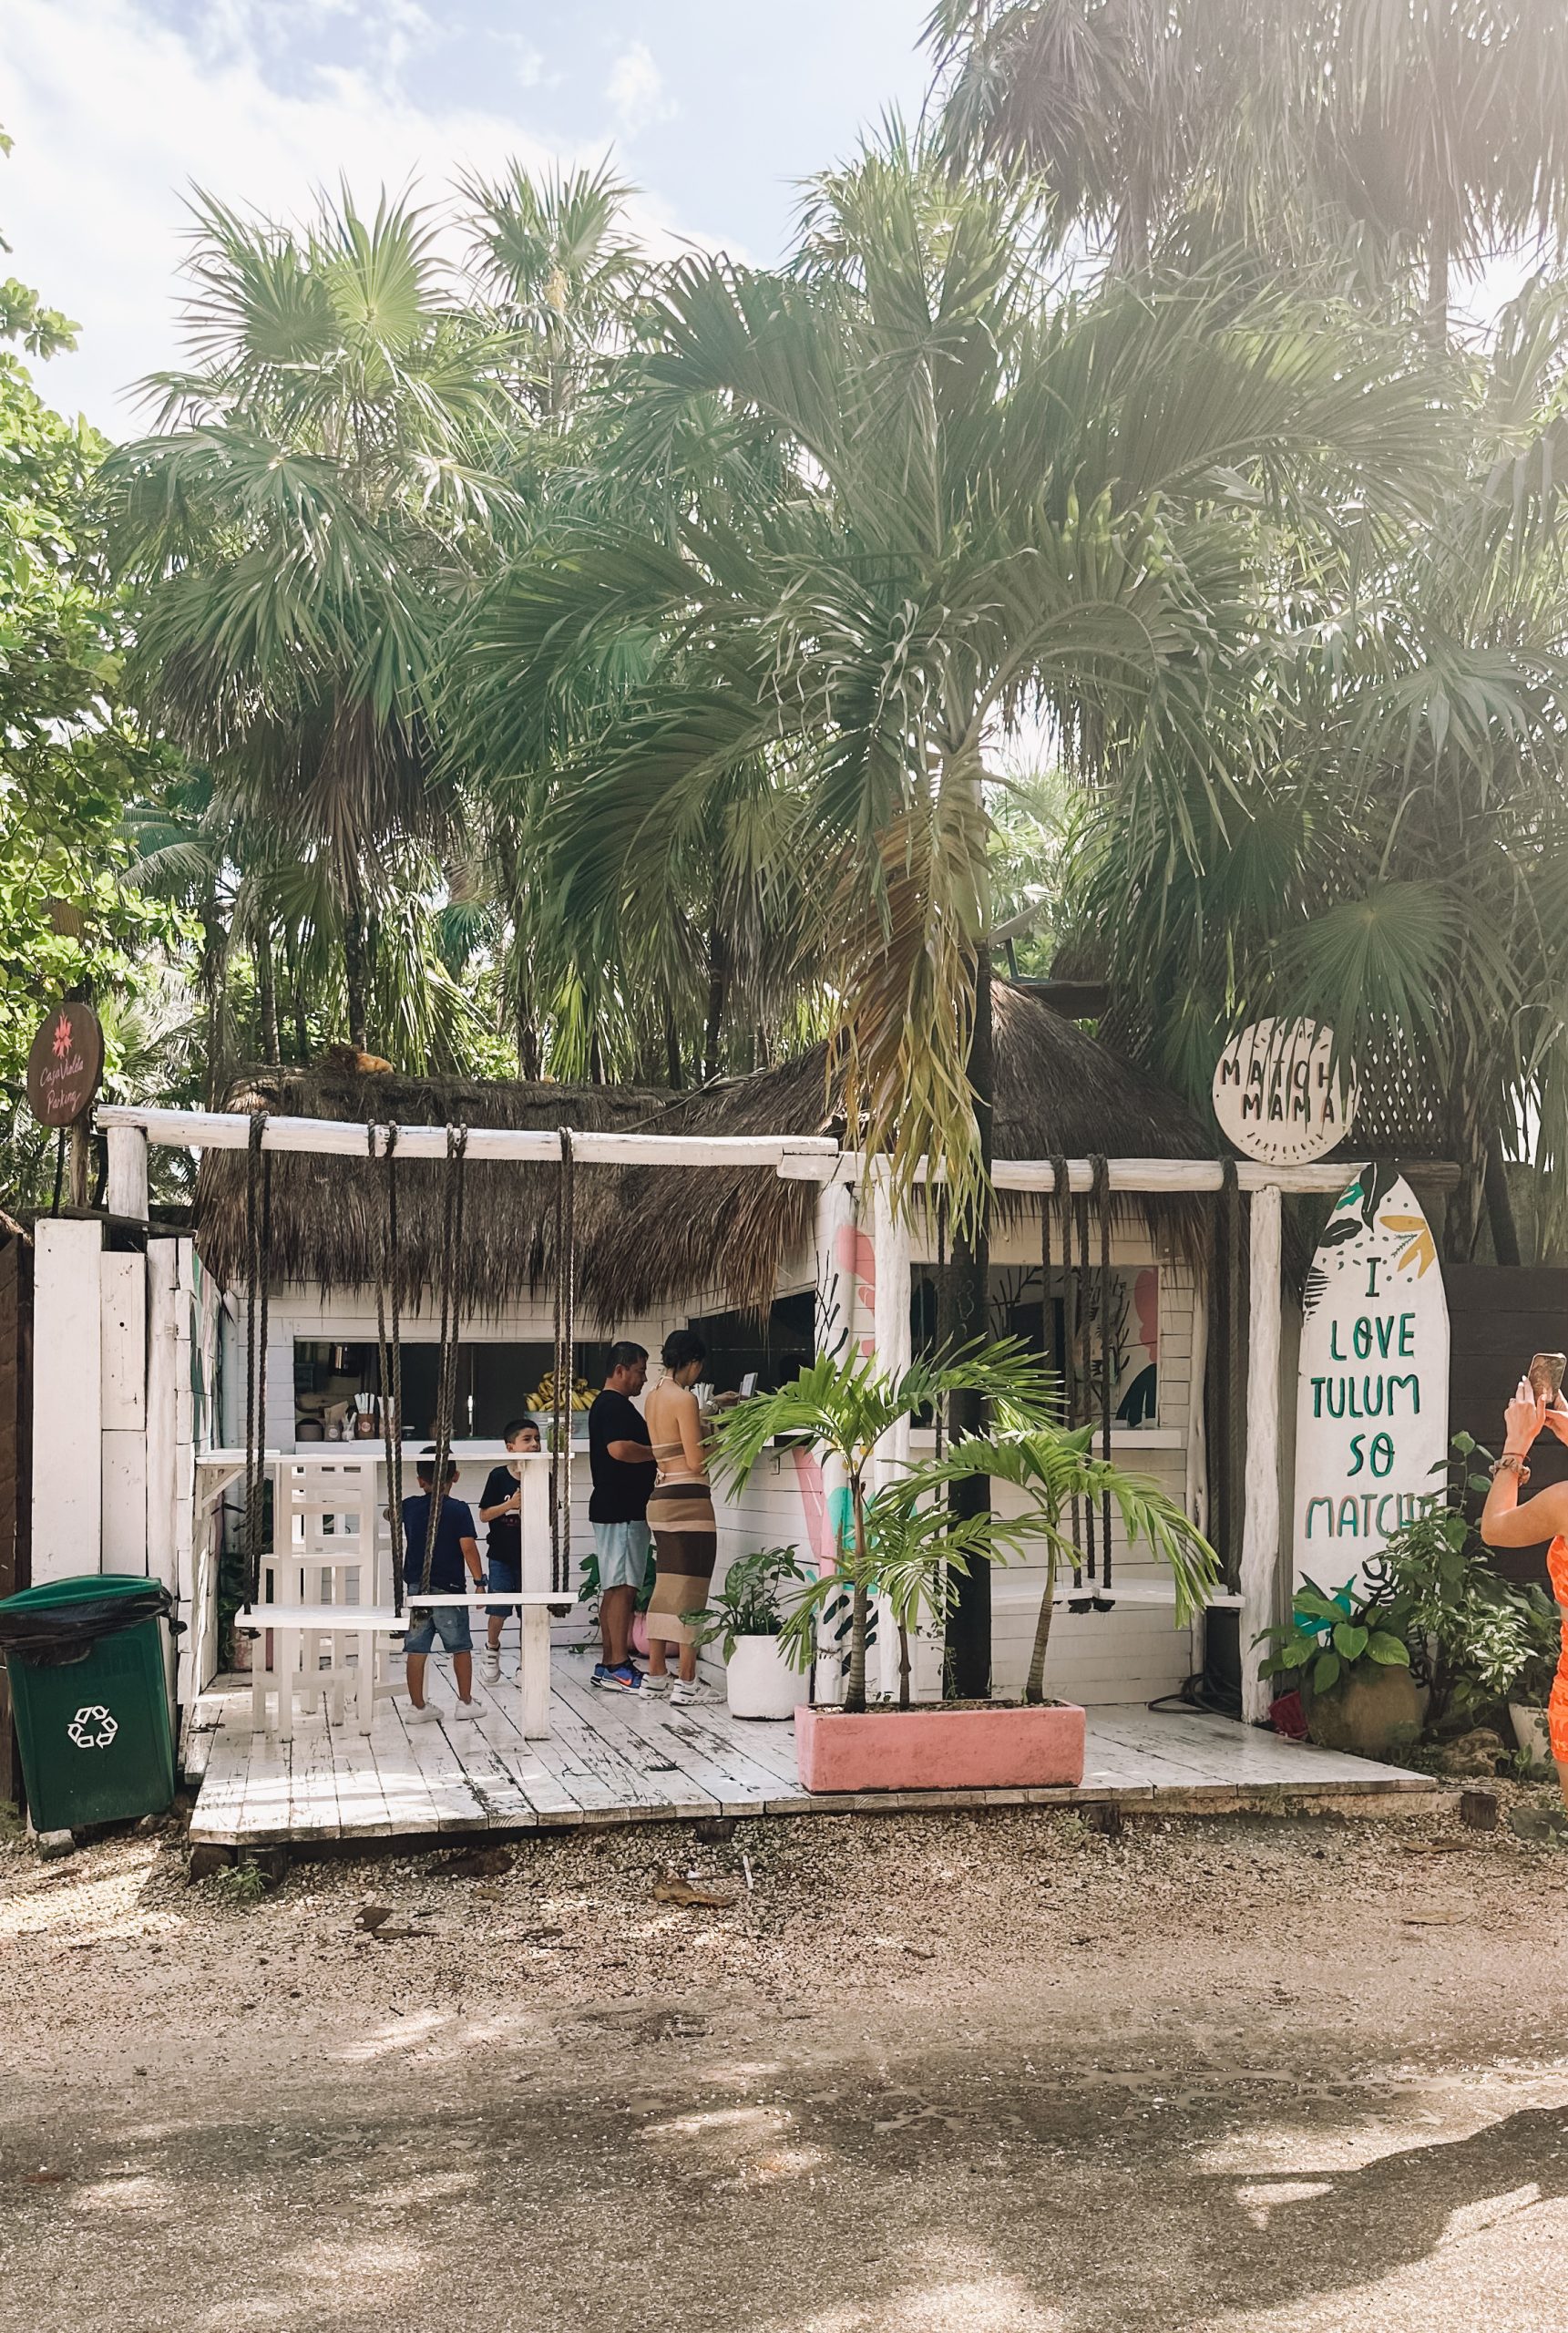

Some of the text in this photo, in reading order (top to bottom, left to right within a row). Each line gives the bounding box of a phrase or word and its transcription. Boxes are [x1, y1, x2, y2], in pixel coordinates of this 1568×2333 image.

[1220, 1058, 1356, 1091] MATCH
[46, 1088, 82, 1115] Parking
[1242, 1093, 1335, 1124] MAMA
[1365, 1257, 1382, 1298] I
[1330, 1312, 1416, 1362] LOVE
[1310, 1373, 1420, 1419] TULUM
[1347, 1432, 1396, 1478] SO
[1305, 1492, 1436, 1539] MATCH
